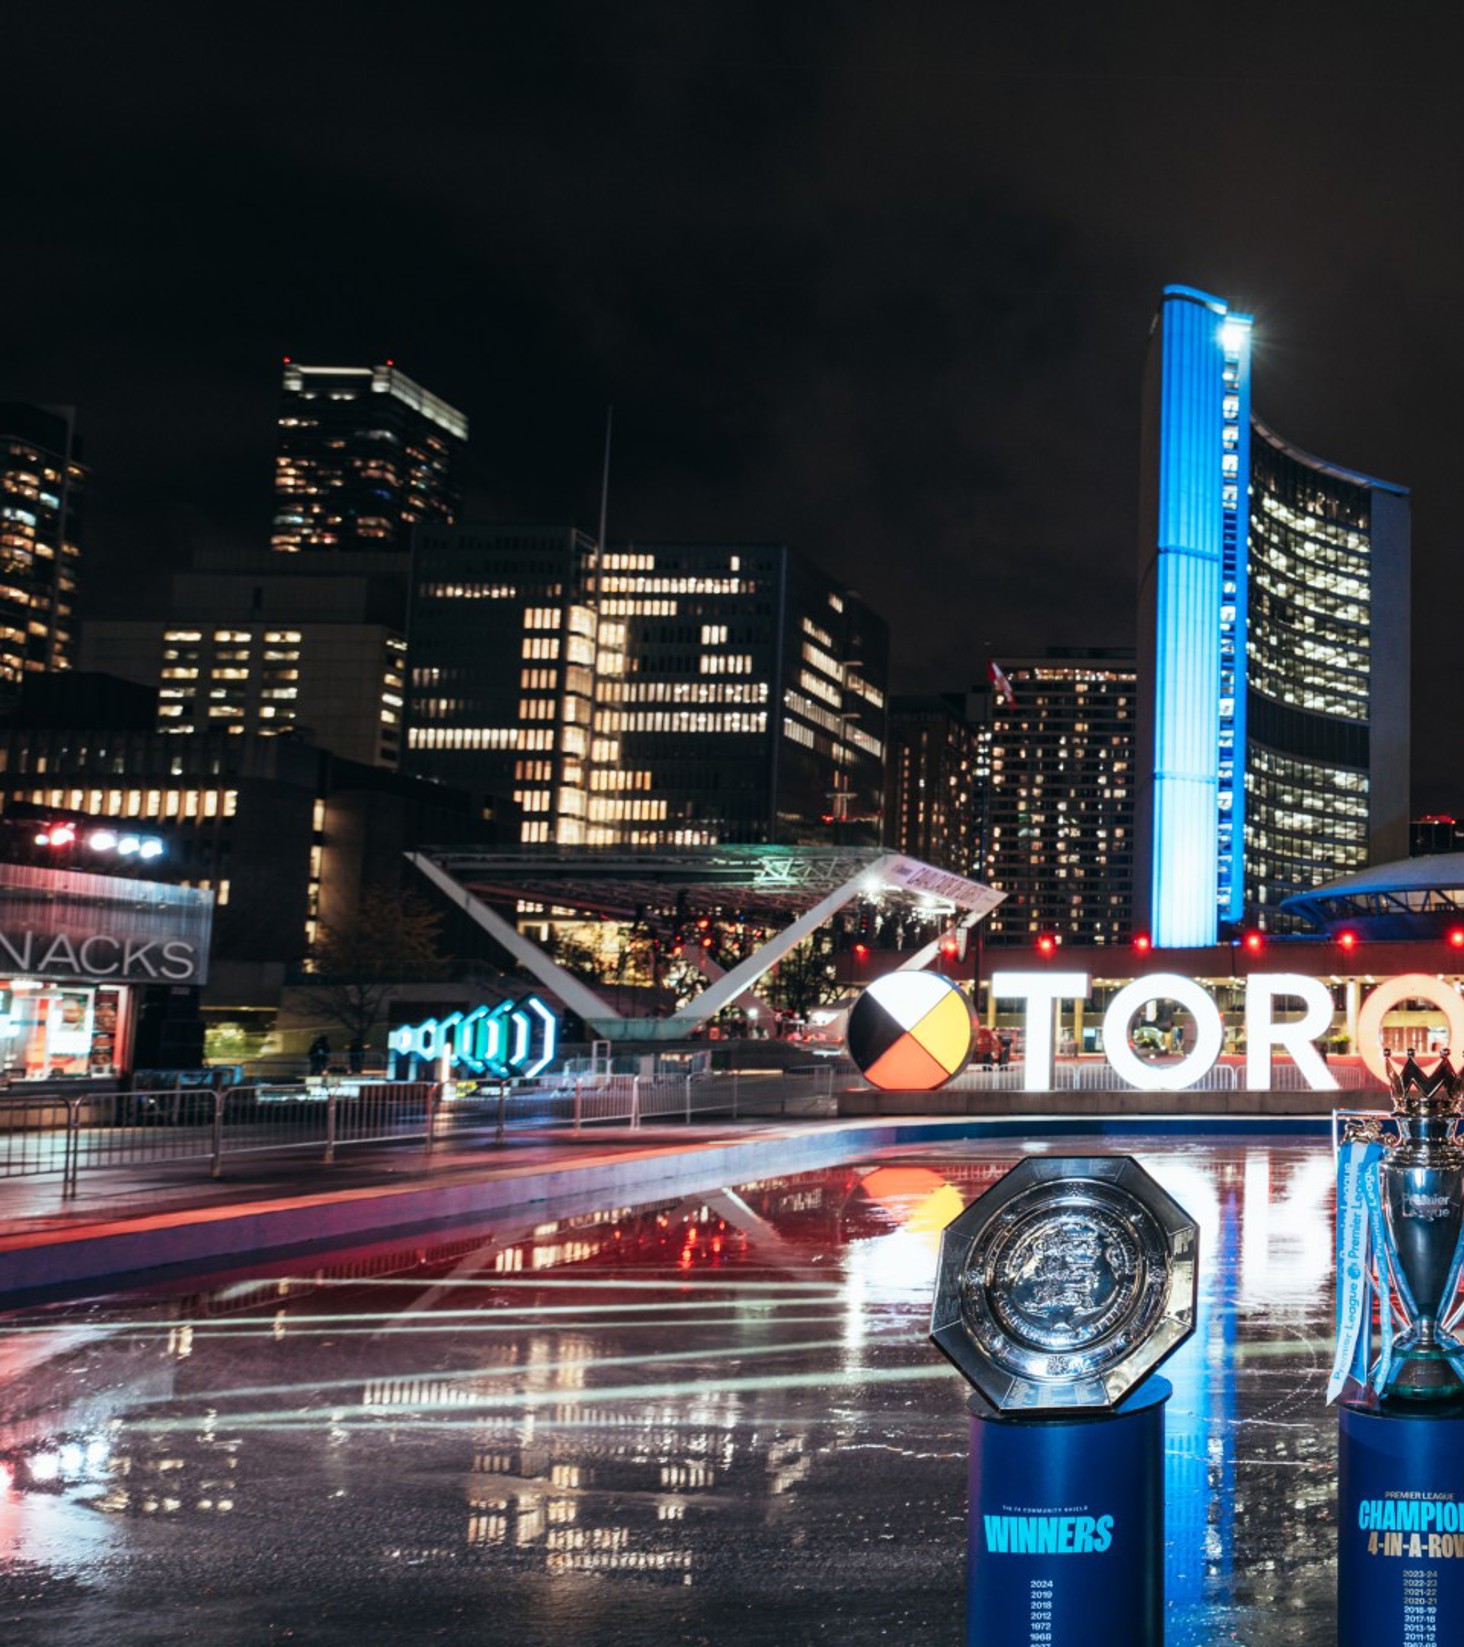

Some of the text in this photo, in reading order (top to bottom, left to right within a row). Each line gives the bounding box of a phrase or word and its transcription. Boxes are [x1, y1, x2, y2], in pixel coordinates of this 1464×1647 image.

[1364, 1165, 1378, 1207] Leagu
[1348, 1212, 1362, 1259] Premier
[1346, 1282, 1360, 1330] League
[1333, 1334, 1351, 1380] Premier
[1384, 1491, 1455, 1501] PREMIER LEAGUE
[983, 1514, 1115, 1555] WINNERS
[1403, 1569, 1437, 1578] 2023-24
[1030, 1580, 1053, 1588] 2024
[1403, 1579, 1437, 1587] 2022-23
[1030, 1590, 1053, 1599] 2019
[1403, 1588, 1437, 1596] 2021-22
[1030, 1600, 1053, 1609] 2018
[1403, 1597, 1437, 1605] 2020-21
[1403, 1605, 1437, 1614] 2018-19
[1030, 1611, 1053, 1620] 2012
[1403, 1615, 1437, 1623] 2017-18
[1030, 1622, 1053, 1631] 1972
[1403, 1624, 1437, 1632] 2013-14
[1403, 1633, 1437, 1641] 2011-12
